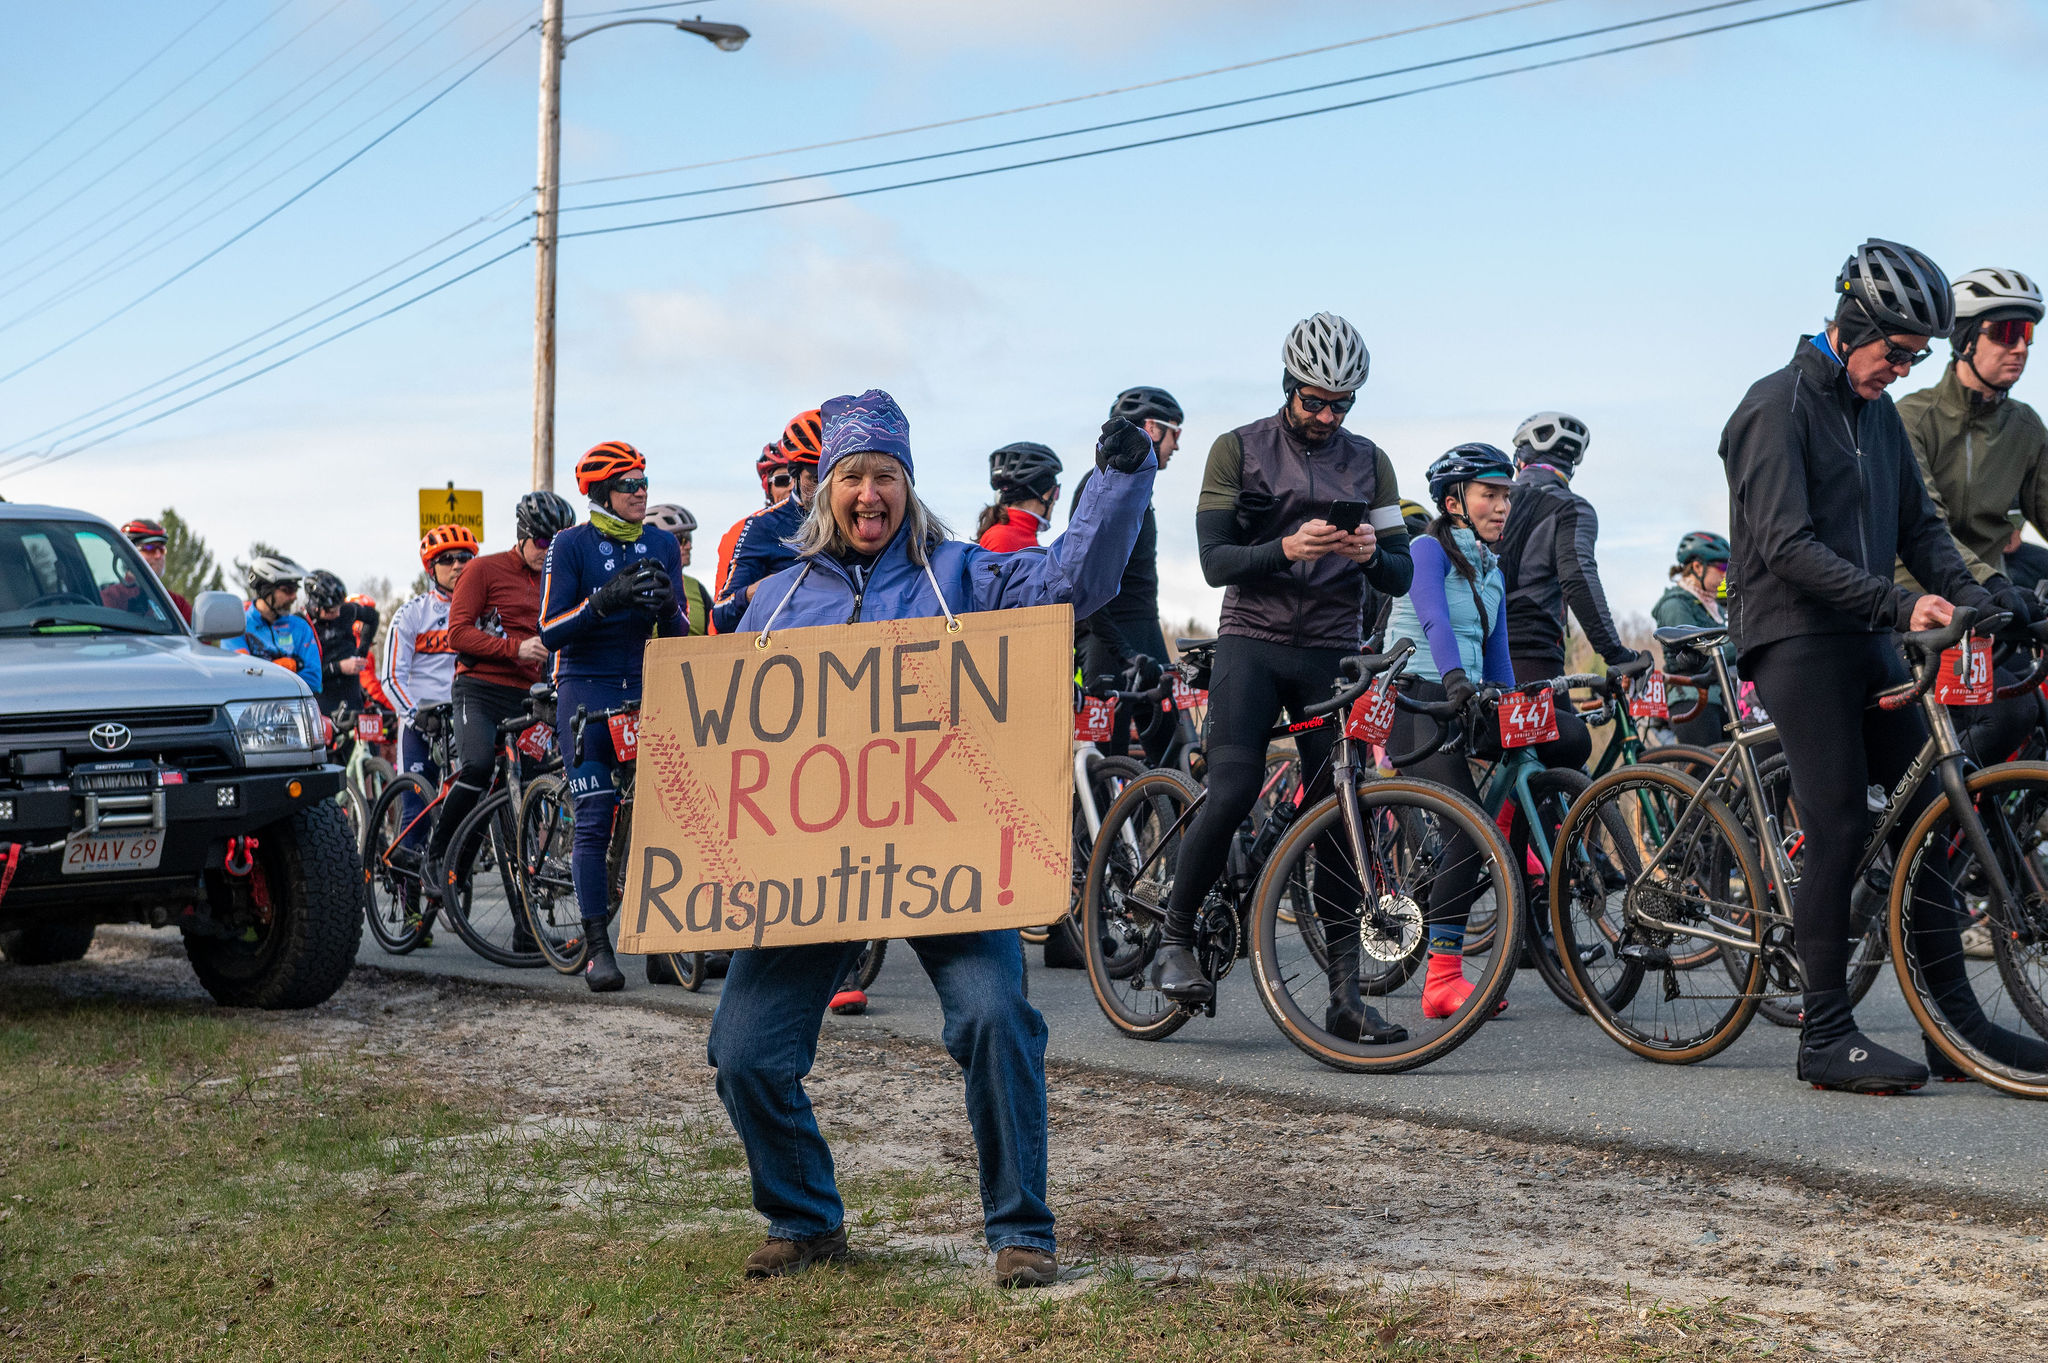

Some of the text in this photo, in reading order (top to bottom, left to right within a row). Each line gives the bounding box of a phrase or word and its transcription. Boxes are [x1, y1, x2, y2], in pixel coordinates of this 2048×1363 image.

[421, 512, 482, 527] UNLOADING
[733, 519, 753, 560] KISSENA
[681, 635, 1009, 747] WOMEN
[1088, 707, 1109, 728] 25
[1288, 717, 1324, 732] cervélo
[1364, 695, 1396, 730] 333
[1510, 701, 1549, 730] 447
[360, 720, 379, 734] 803
[727, 733, 957, 840] ROCK
[69, 839, 157, 864] 2NAV 69
